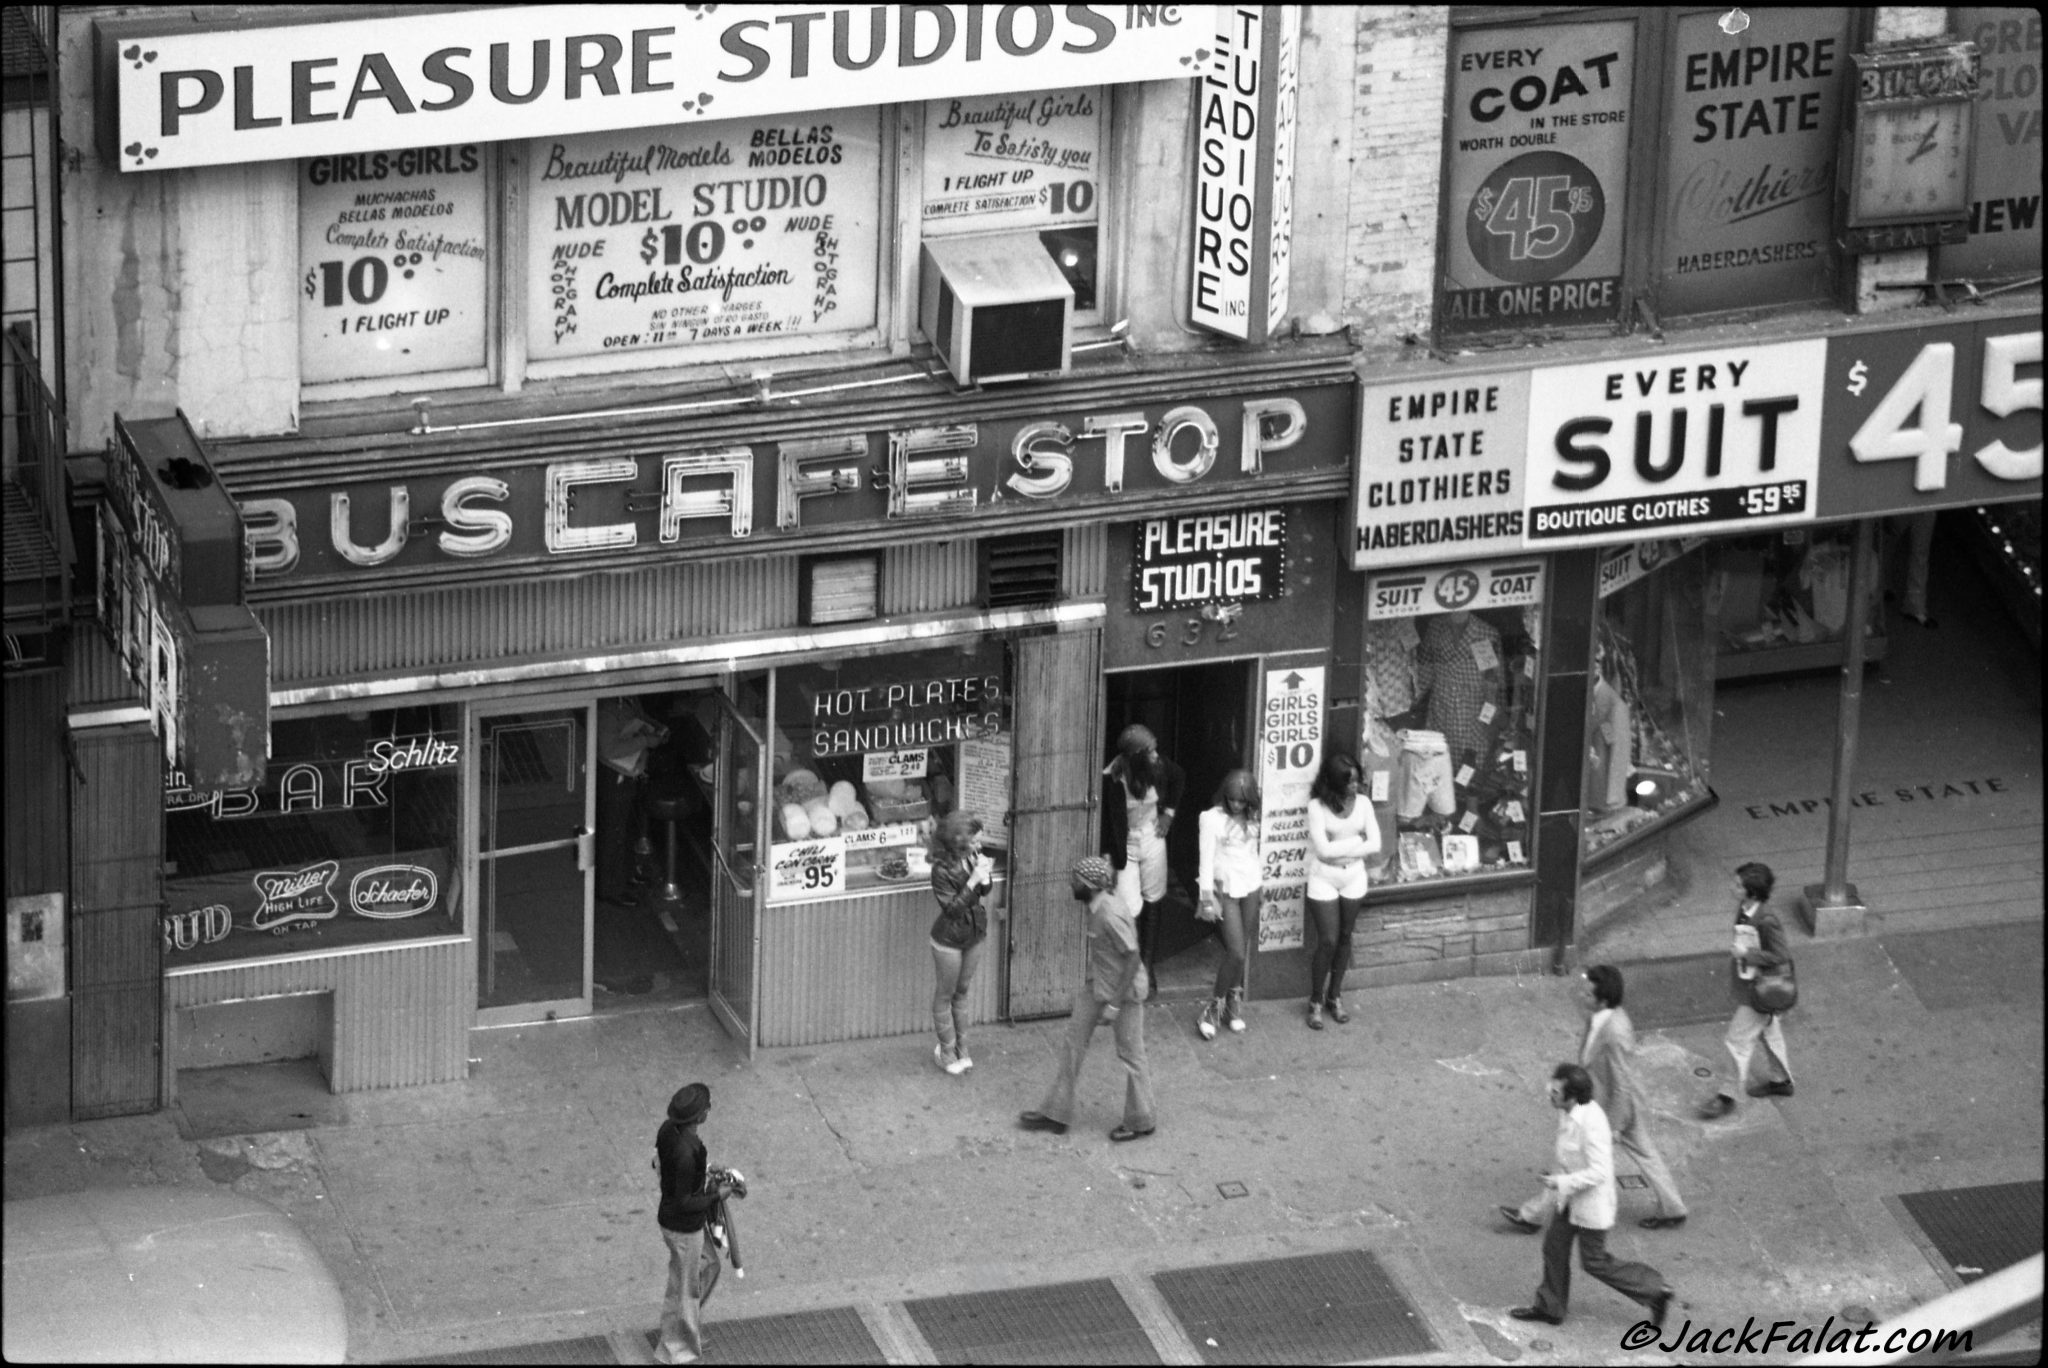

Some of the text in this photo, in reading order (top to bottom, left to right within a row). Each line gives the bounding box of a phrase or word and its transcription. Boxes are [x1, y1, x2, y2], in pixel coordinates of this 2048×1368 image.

[160, 26, 676, 137] PLEASURE
[716, 4, 1117, 83] STUDIOS
[1460, 47, 1543, 73] EVERY
[1685, 37, 1836, 92] EMPIRE
[1469, 52, 1619, 123] COAT
[939, 93, 1093, 129] Beautiful Girls
[1530, 110, 1626, 130] IN THE STORE
[1693, 92, 1821, 143] STATE
[750, 125, 834, 148] BELLAS
[974, 129, 994, 153] To
[1058, 149, 1092, 167] you
[1459, 132, 1557, 152] WORTH DOUBLE
[541, 141, 734, 184] Beautiful Models
[749, 144, 843, 168] MODELOS
[943, 169, 1034, 191] 1 FLIGHT UP
[354, 188, 436, 206] MUCHACHAS
[555, 173, 827, 231] MODEL STUDIO
[924, 193, 1037, 216] COMPLETE SATISFACTION
[1038, 179, 1094, 215] $10
[338, 202, 454, 224] BELLAS MODELOS
[784, 214, 834, 233] NUDE
[326, 222, 485, 262] Complete Satisfaction
[552, 239, 606, 260] NUDE
[1677, 240, 1818, 274] HABERDASHERS
[595, 262, 795, 303] Complete Satisfaction
[651, 309, 667, 320] NO
[671, 305, 709, 318] OTHER
[1450, 280, 1613, 320] ALL ONE PRICE
[341, 308, 450, 334] 1 FLIGHT UP
[650, 320, 666, 331] SIN
[713, 314, 738, 324] OTRO
[690, 328, 698, 341] 7
[702, 325, 730, 338] DAYS
[734, 325, 741, 335] A
[747, 320, 783, 334] WEEK
[1605, 359, 1750, 401] EVERY
[1388, 386, 1500, 423] EMPIRE
[1399, 430, 1484, 464] STATE
[1552, 394, 1800, 491] SUIT
[246, 397, 1308, 577] BUS CAFE STOP
[1367, 468, 1511, 510] CLOTHIERS
[1536, 496, 1710, 532] BOUTIQUE CLOTHES
[1144, 510, 1281, 561] PLEASURE
[1356, 509, 1523, 551] HABERDASHERS
[1602, 554, 1632, 584] SUIT
[1376, 587, 1423, 608] SUIT
[1490, 576, 1536, 596] COAT
[814, 675, 1000, 716] HOT PLATES
[1268, 693, 1318, 712] GIRLS
[1266, 709, 1318, 728] GIRLS
[813, 712, 1000, 757] SANDWICHES
[1266, 725, 1319, 744] GIRLS
[368, 736, 459, 771] Schlitz
[889, 752, 925, 764] CLAMS
[1267, 742, 1314, 770] $10
[212, 760, 389, 819] BAR
[1893, 777, 2009, 803] STATE
[844, 831, 876, 844] CLAMS
[879, 831, 887, 844] 6
[1266, 830, 1309, 843] MODELOS
[1271, 819, 1304, 831] BELLAS
[775, 858, 799, 870] CON
[1267, 847, 1307, 865] OPEN
[265, 867, 330, 899] Miller
[1262, 864, 1282, 881] 24
[265, 895, 323, 914] HIGH LIFE
[358, 880, 429, 904] Schaefer
[1263, 886, 1302, 902] NUDE
[273, 925, 289, 936] ON
